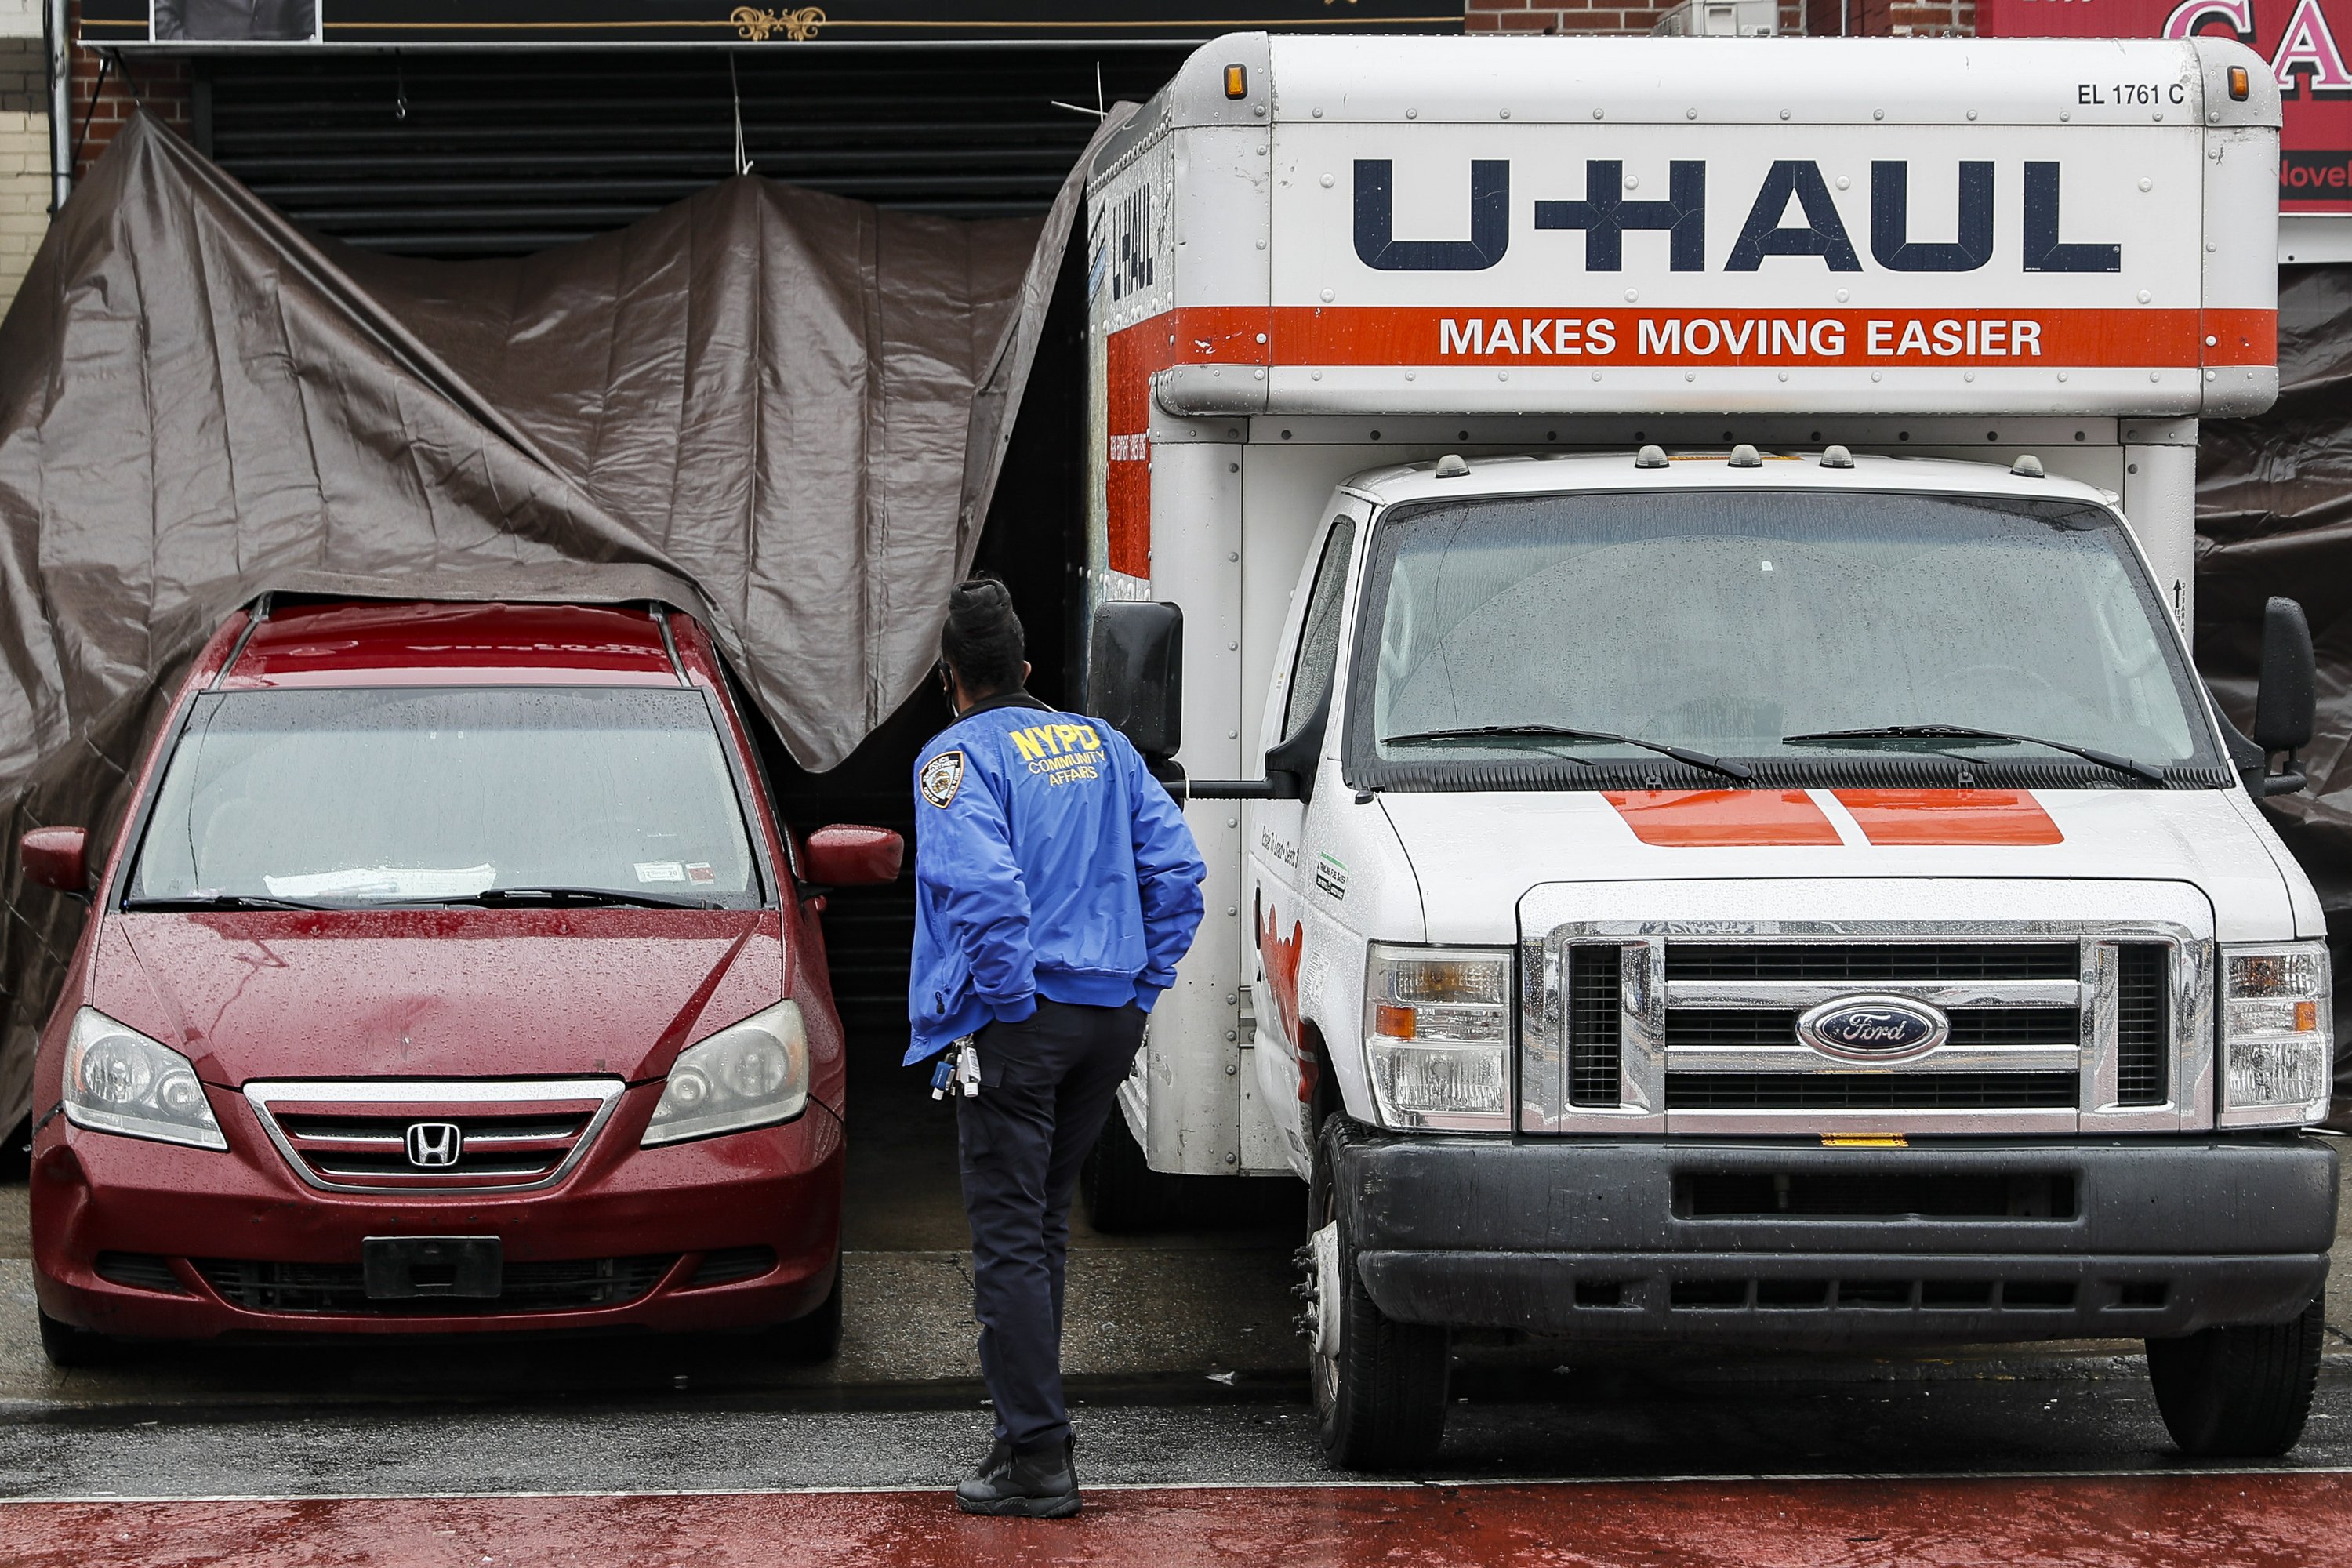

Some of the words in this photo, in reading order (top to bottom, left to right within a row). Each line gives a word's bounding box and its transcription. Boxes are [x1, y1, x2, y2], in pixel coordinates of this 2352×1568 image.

[2079, 85, 2104, 104] EL
[2114, 85, 2158, 104] 1761
[2169, 84, 2183, 103] C
[1354, 160, 2121, 272] U-HAUL
[1441, 319, 1615, 354] MAKES
[1639, 319, 1845, 355] MOVING
[1868, 320, 2041, 355] EASIER
[1009, 724, 1102, 761] NYPD
[1028, 750, 1106, 775] COMMUNITY
[1049, 765, 1098, 786] AFFAIRS
[1842, 1013, 1907, 1041] Ford
